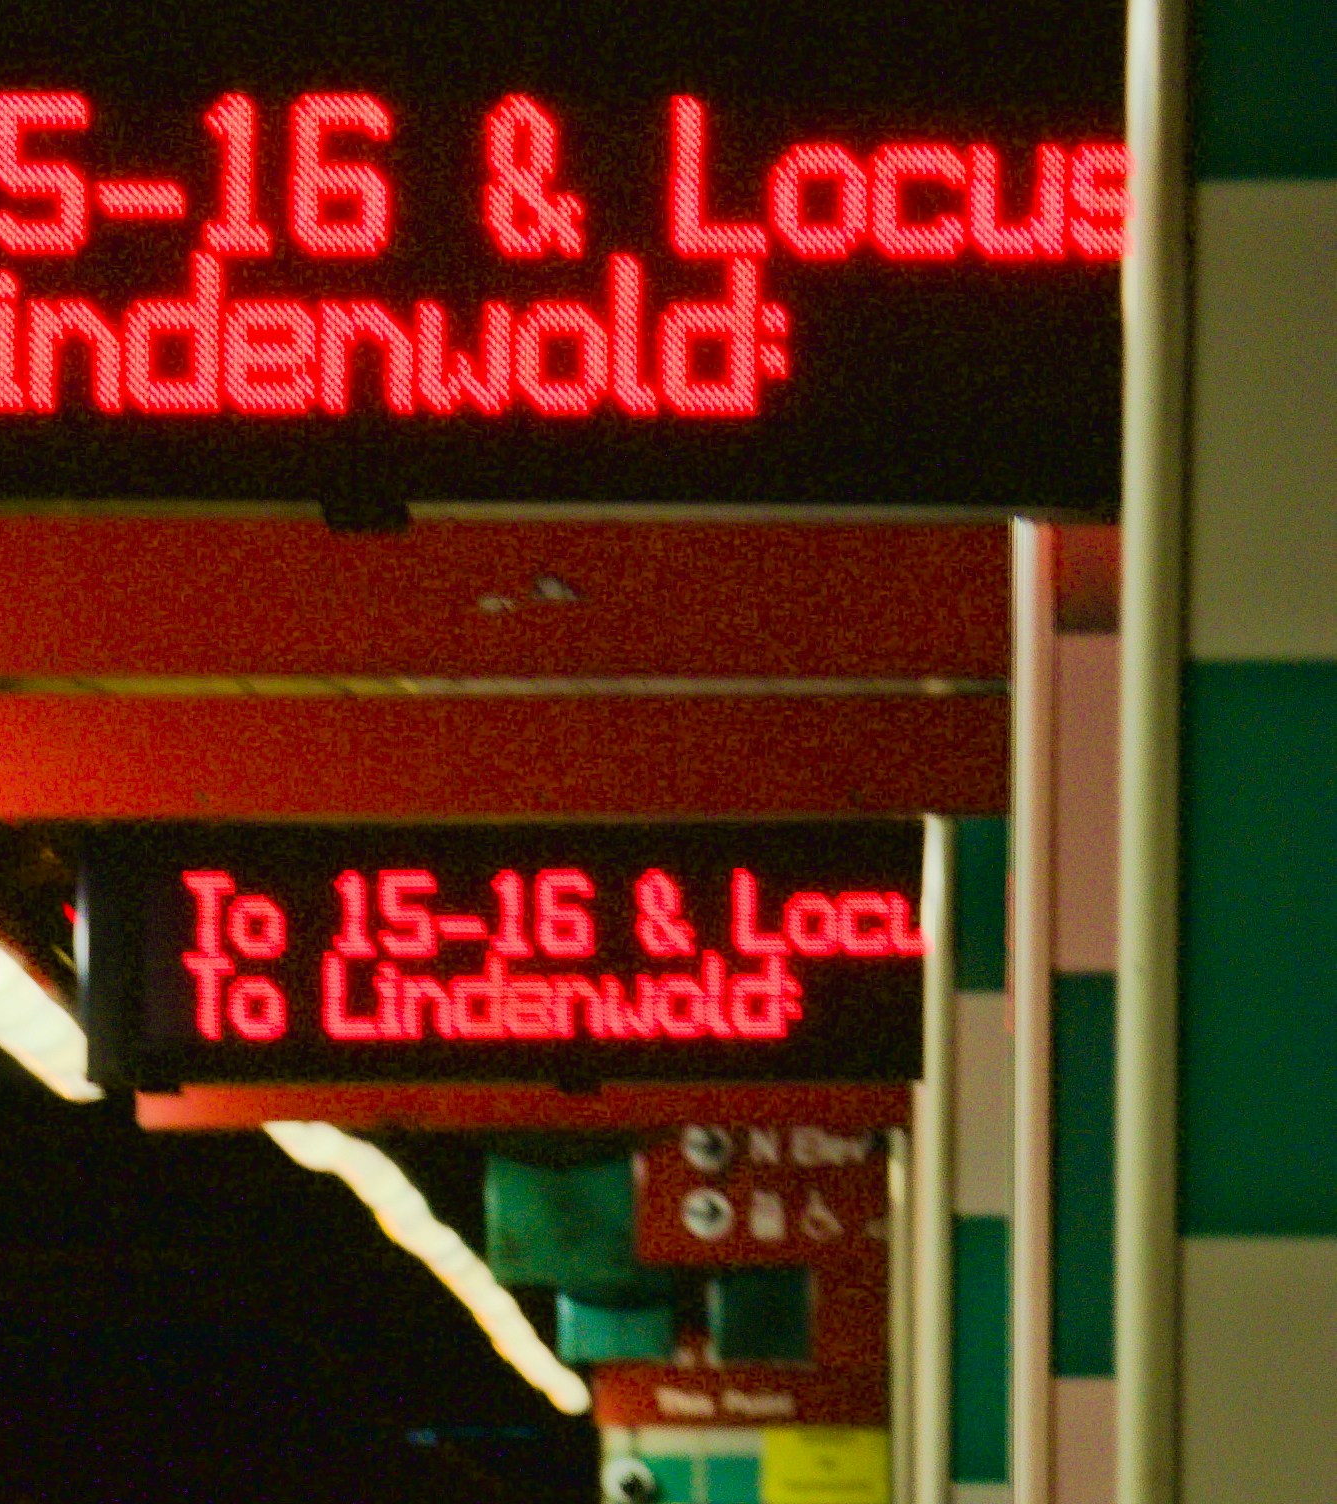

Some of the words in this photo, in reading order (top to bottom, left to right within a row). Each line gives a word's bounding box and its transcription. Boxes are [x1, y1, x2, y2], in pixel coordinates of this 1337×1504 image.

[483, 93, 585, 258] &
[670, 94, 1133, 262] Locus
[182, 869, 287, 959] To
[333, 868, 596, 958] 15-16
[635, 868, 695, 958] &
[182, 950, 287, 1040] To
